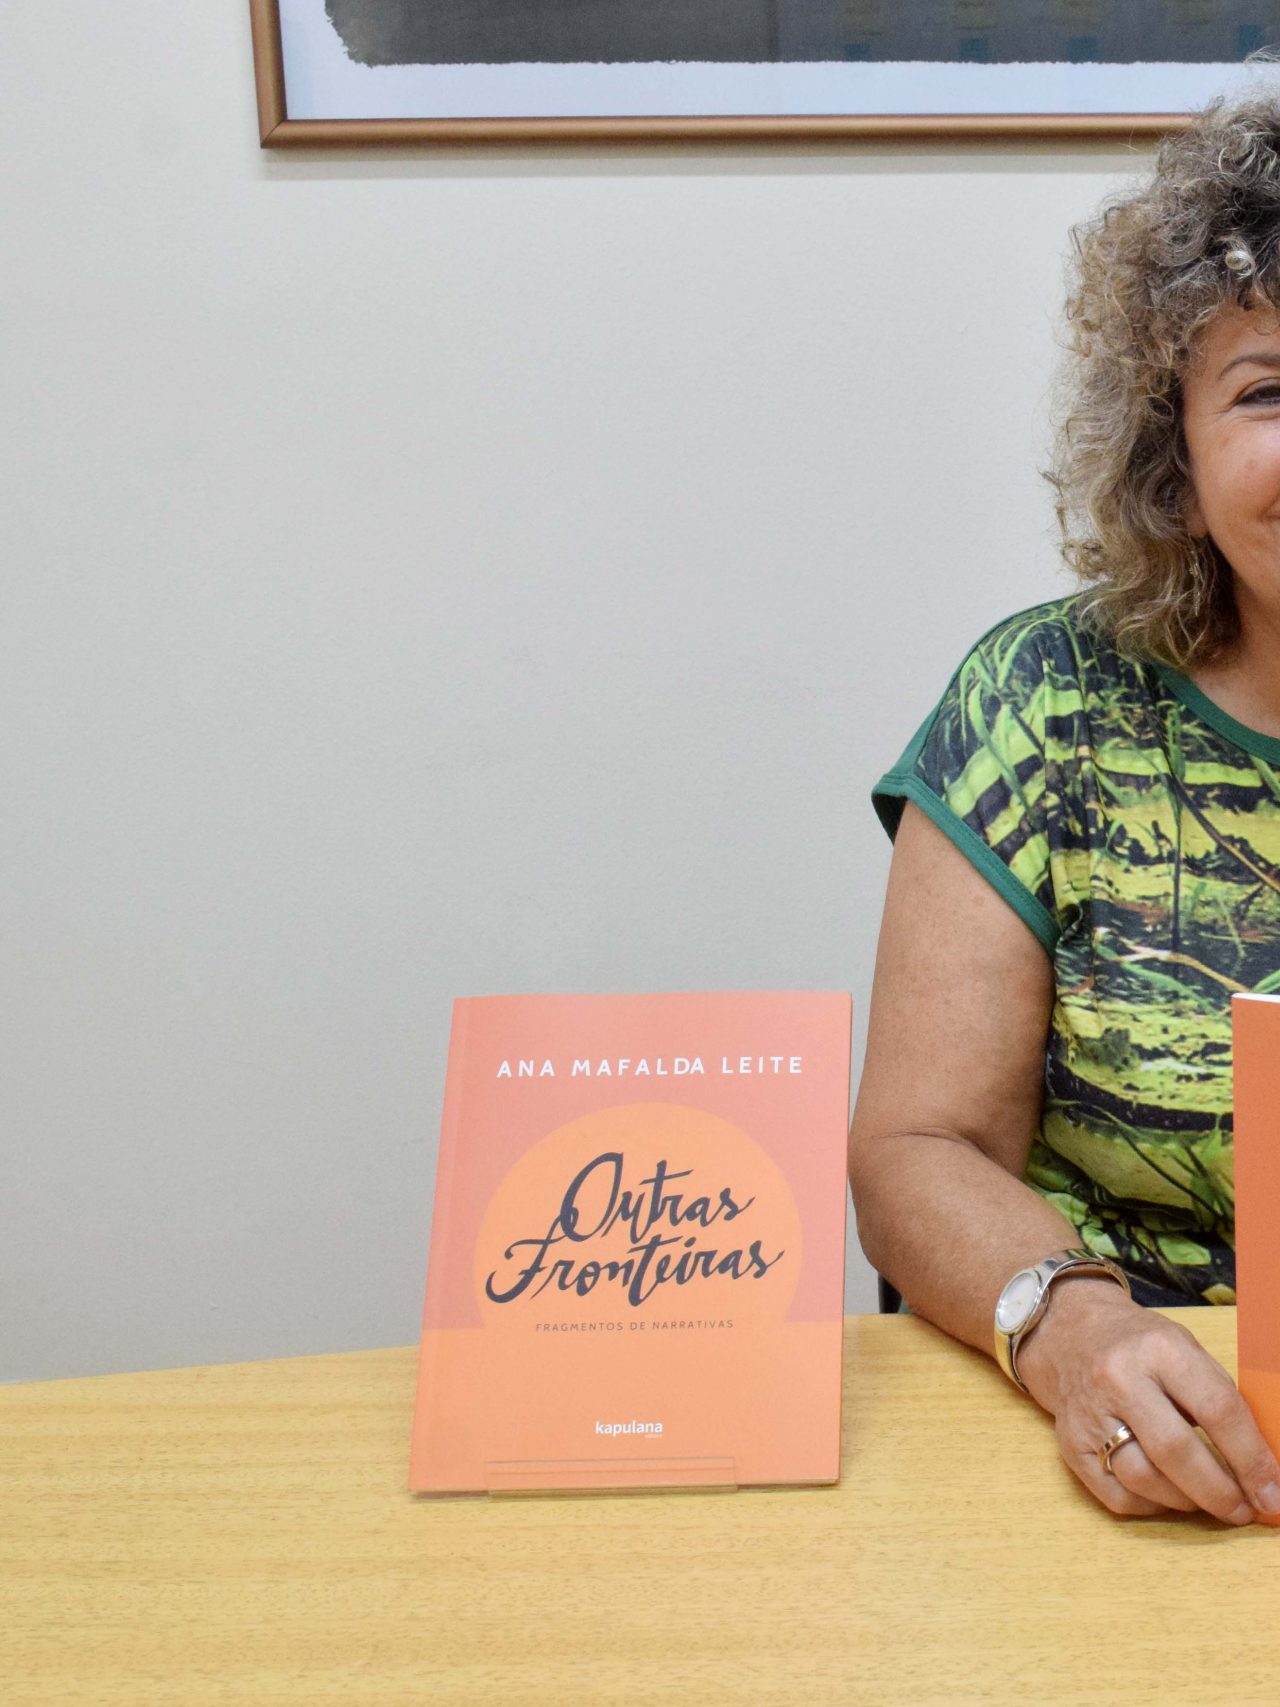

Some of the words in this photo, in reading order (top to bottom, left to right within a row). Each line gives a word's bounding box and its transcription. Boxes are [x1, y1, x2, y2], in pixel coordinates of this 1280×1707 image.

[496, 1059, 555, 1078] ANA
[571, 1057, 705, 1076] MAFALDA
[722, 1056, 803, 1074] LEITE
[559, 1151, 756, 1245] Outras
[485, 1215, 786, 1307] Fronteiras
[535, 1321, 624, 1333] FRAGMENTOS
[630, 1321, 646, 1331] DE
[652, 1319, 734, 1330] NARRATIVAS
[595, 1420, 663, 1437] kapulana
